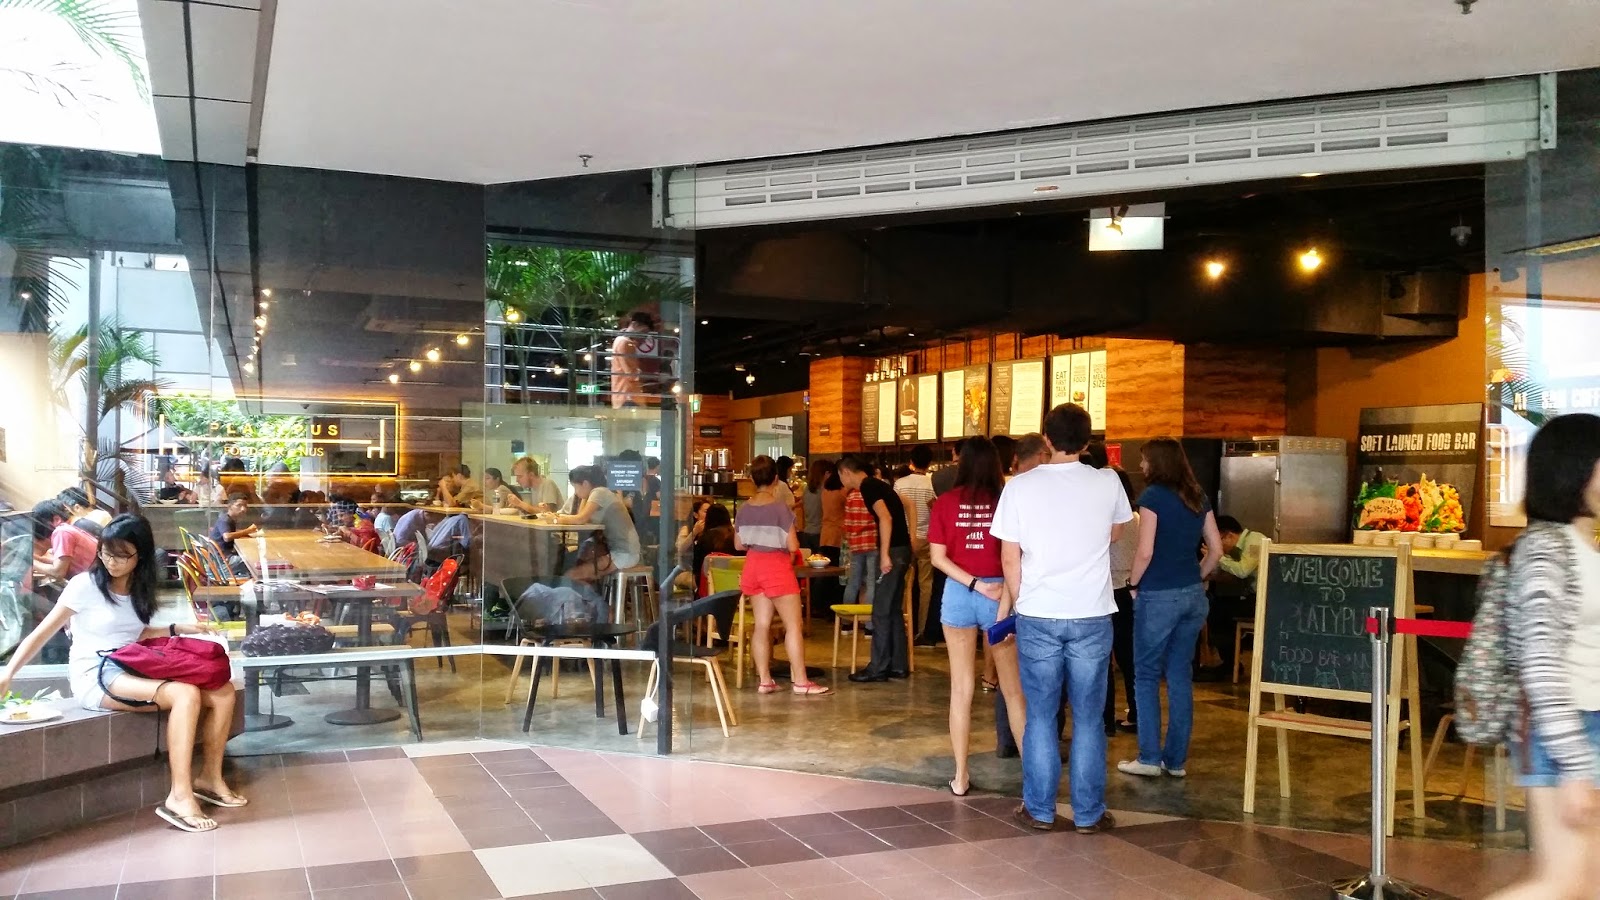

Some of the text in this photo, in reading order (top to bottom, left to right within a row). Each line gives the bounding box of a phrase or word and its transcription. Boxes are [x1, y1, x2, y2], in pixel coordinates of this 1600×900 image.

[1056, 371, 1067, 379] EAT
[581, 385, 595, 393] EXIT
[1092, 380, 1106, 388] SIZE
[1360, 431, 1477, 452] SOFT LAUNCH FOOD BAR
[223, 446, 258, 456] FOOD
[300, 447, 324, 456] NUS
[1280, 557, 1384, 588] WELCOME
[1320, 586, 1346, 603] TO
[1280, 645, 1314, 664] FOOD
